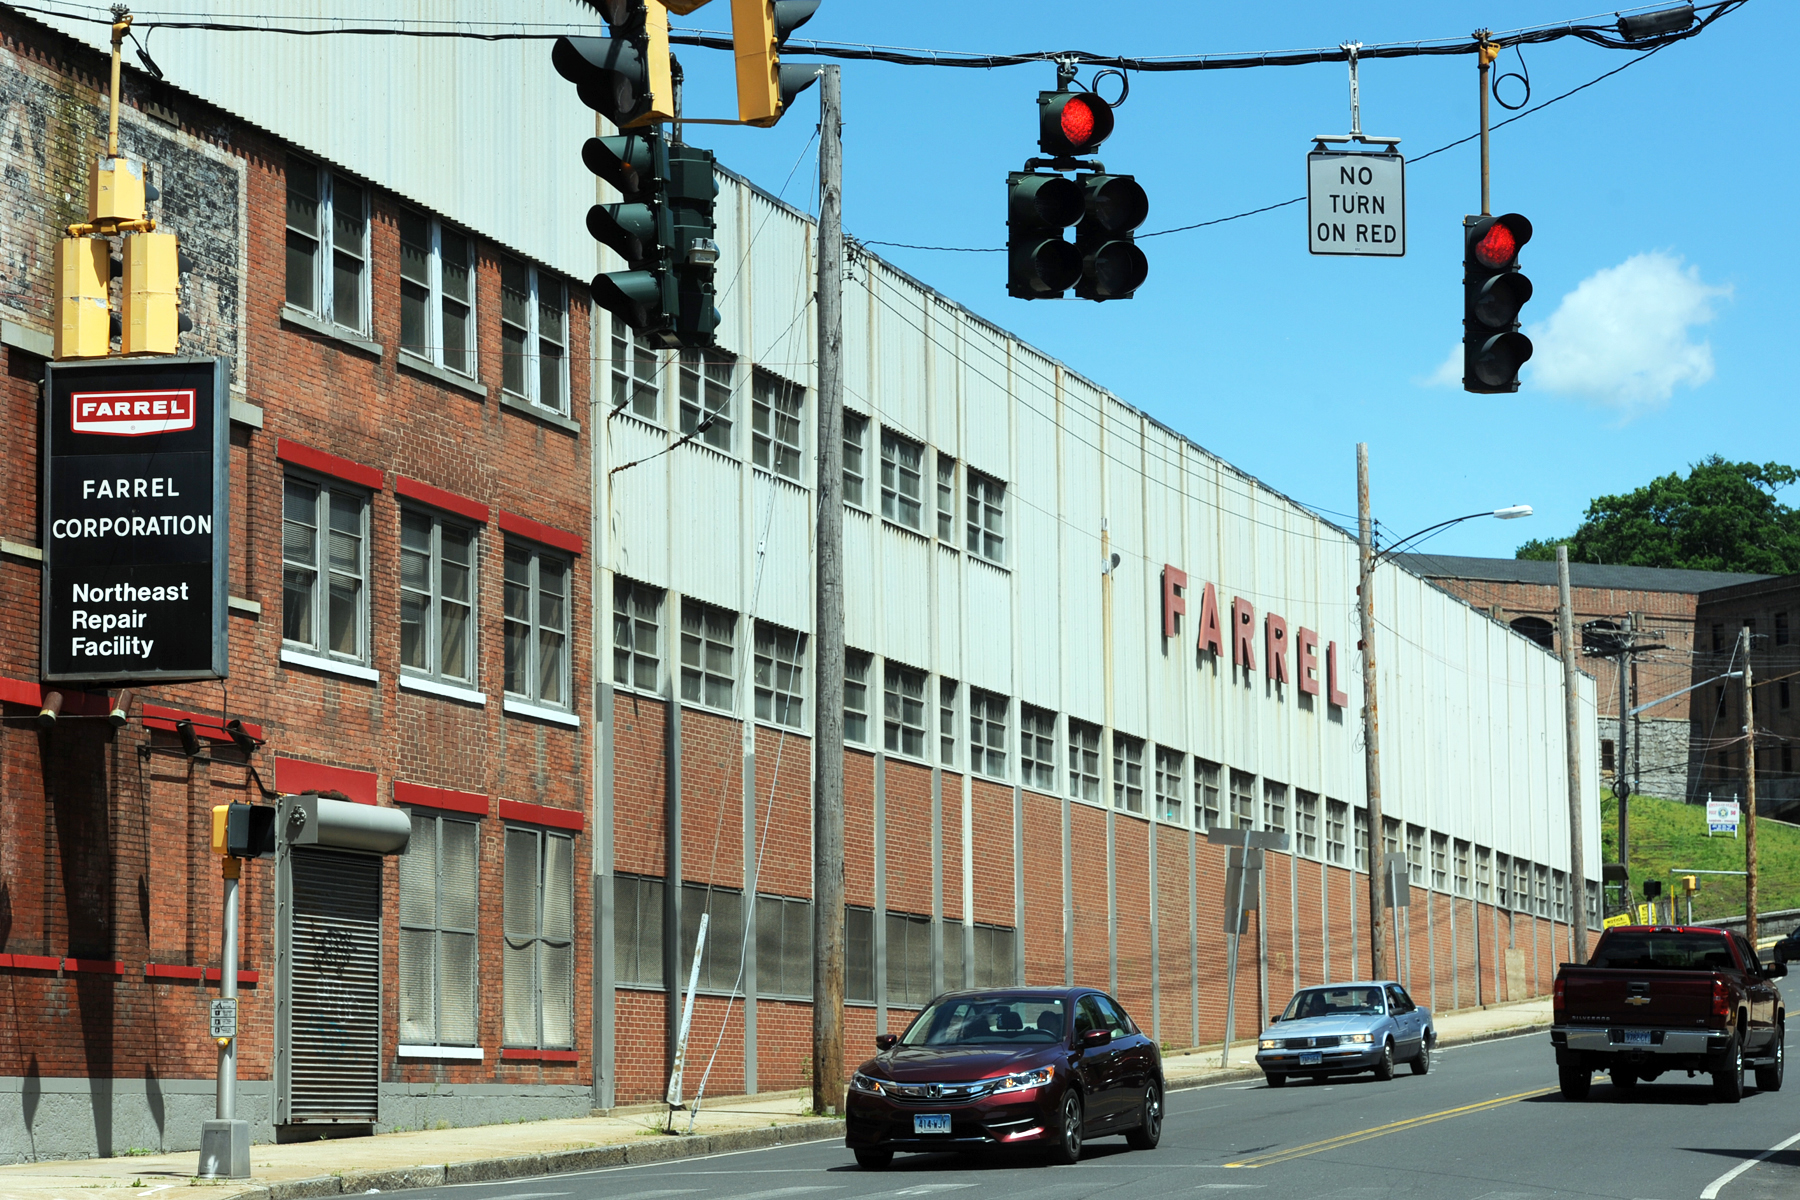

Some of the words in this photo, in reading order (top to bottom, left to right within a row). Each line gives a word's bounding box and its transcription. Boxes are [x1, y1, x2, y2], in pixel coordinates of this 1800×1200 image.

[1340, 166, 1373, 185] NO
[1329, 194, 1385, 214] TURN
[1317, 222, 1345, 242] ON
[1356, 224, 1396, 243] RED
[81, 400, 185, 417] FARREL
[83, 477, 180, 499] FARREL
[52, 514, 212, 539] CORPORATION
[72, 582, 189, 603] Northeast
[72, 609, 147, 633] Repair
[1163, 563, 1349, 709] FARREL
[71, 635, 154, 659] Facility
